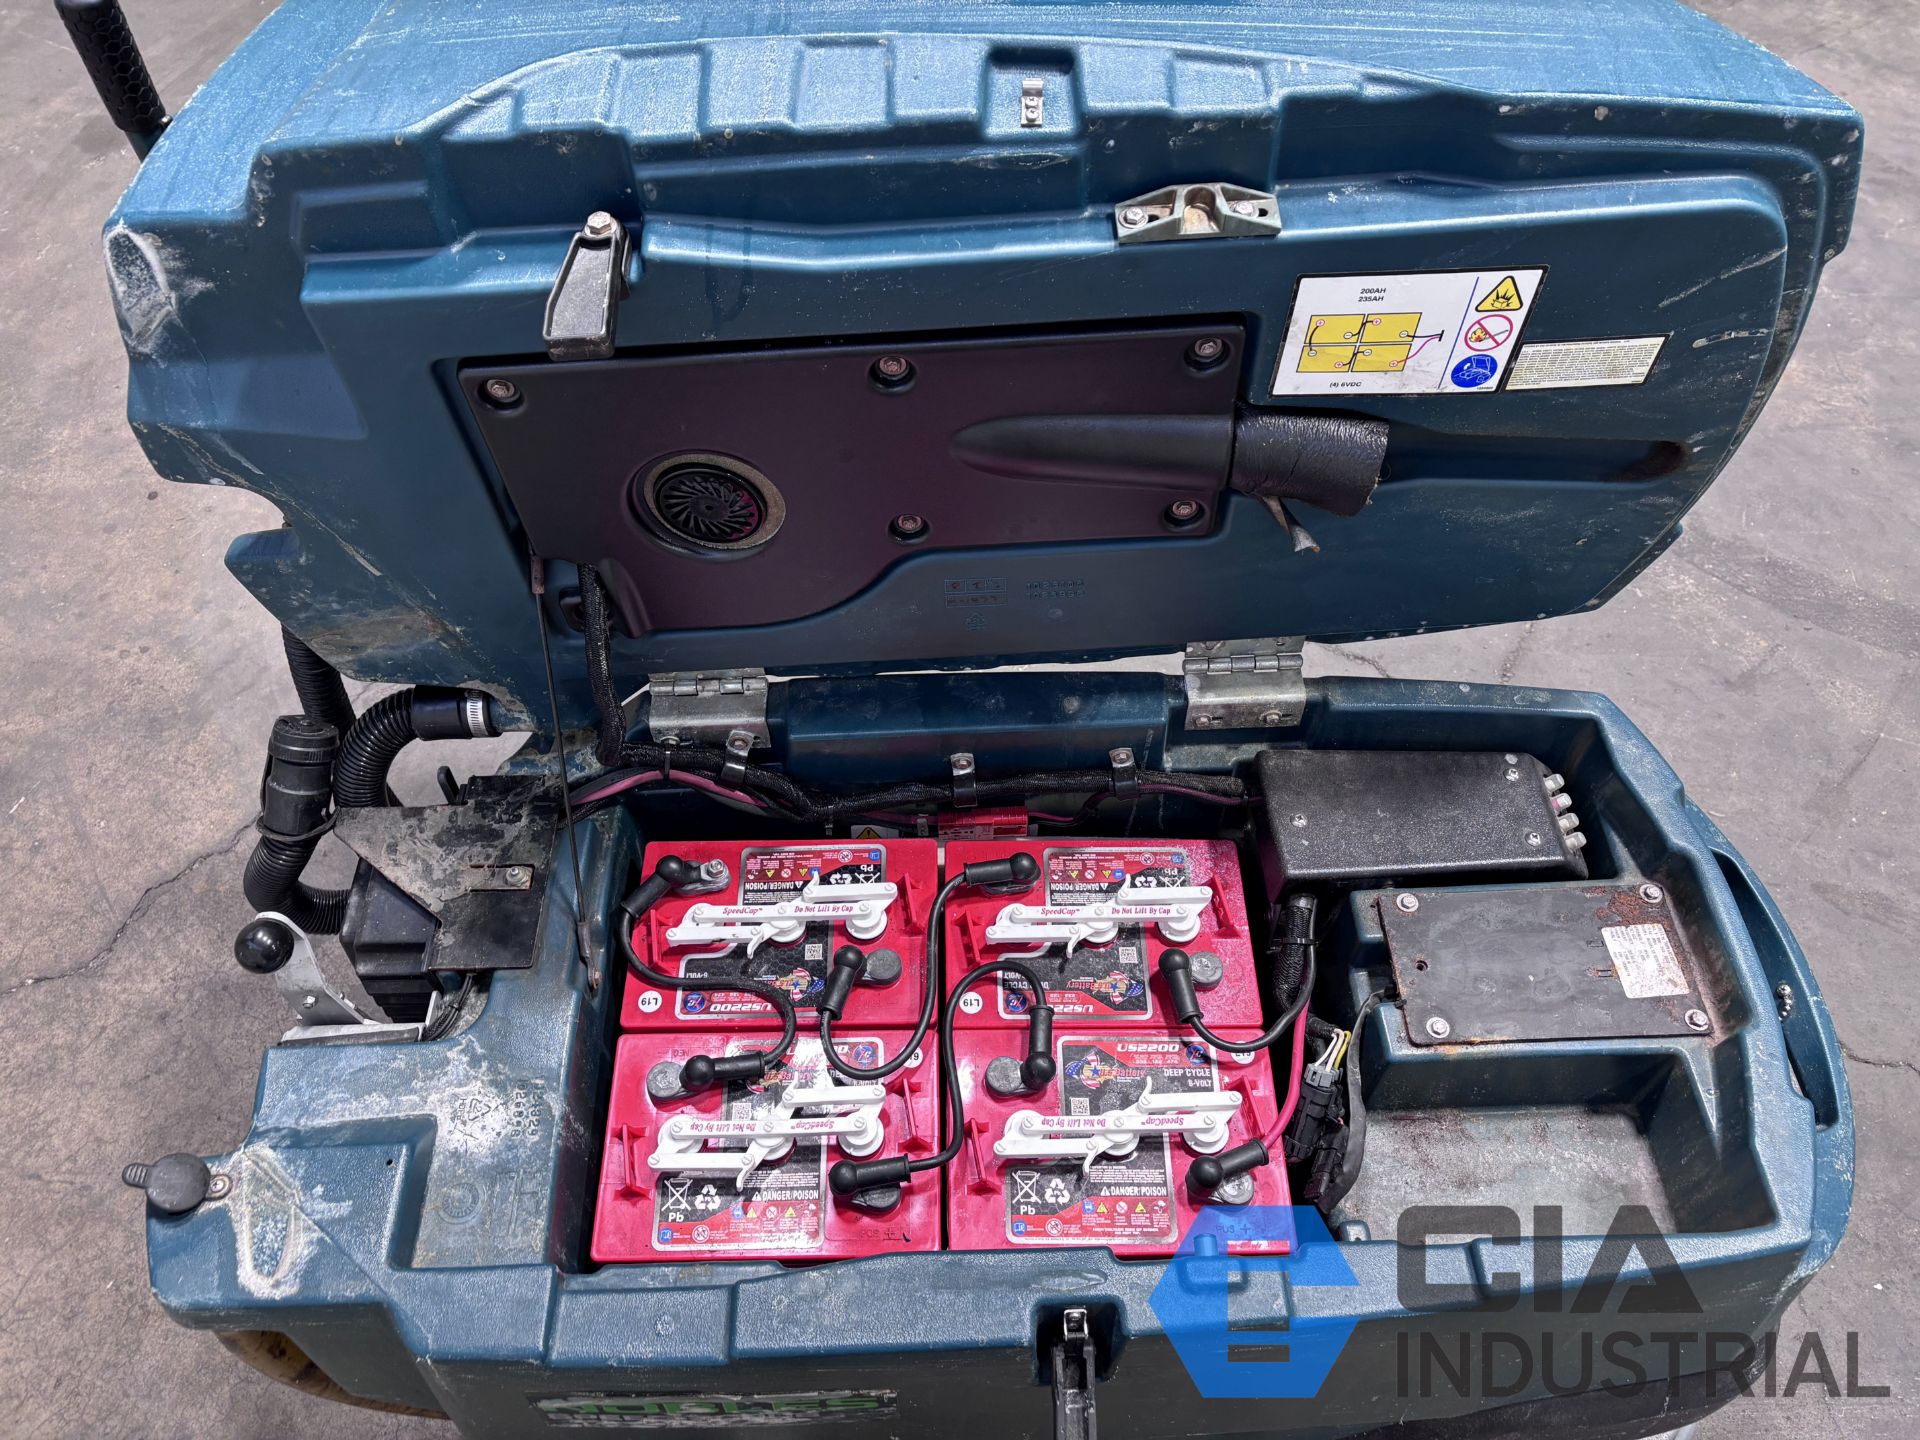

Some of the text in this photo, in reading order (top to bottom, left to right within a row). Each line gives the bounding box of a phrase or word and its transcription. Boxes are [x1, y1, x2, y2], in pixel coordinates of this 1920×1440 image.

[1360, 287, 1387, 295] 200AH
[1358, 295, 1385, 303] 235AH
[860, 864, 874, 872] Pb
[1164, 868, 1178, 876] Pb
[794, 904, 854, 913] Do Not Lift By Cap
[1149, 907, 1158, 915] By
[1158, 907, 1171, 915] Cap
[641, 997, 658, 1008] L19
[709, 1002, 772, 1012] US2200
[963, 998, 980, 1008] L19
[1116, 1043, 1180, 1053] US2200
[1163, 1067, 1211, 1077] DEEP CYCLE
[690, 1122, 704, 1132] Cap
[706, 1122, 714, 1132] By
[732, 1122, 745, 1132] Not
[746, 1122, 756, 1131] Do
[1042, 1118, 1106, 1128] Do Not Lift By Cap
[762, 1190, 819, 1201] DANGER/POISON
[1111, 1186, 1167, 1197] DANGER/POISON
[1020, 1205, 1036, 1215] Pb
[668, 1212, 684, 1222] Pb
